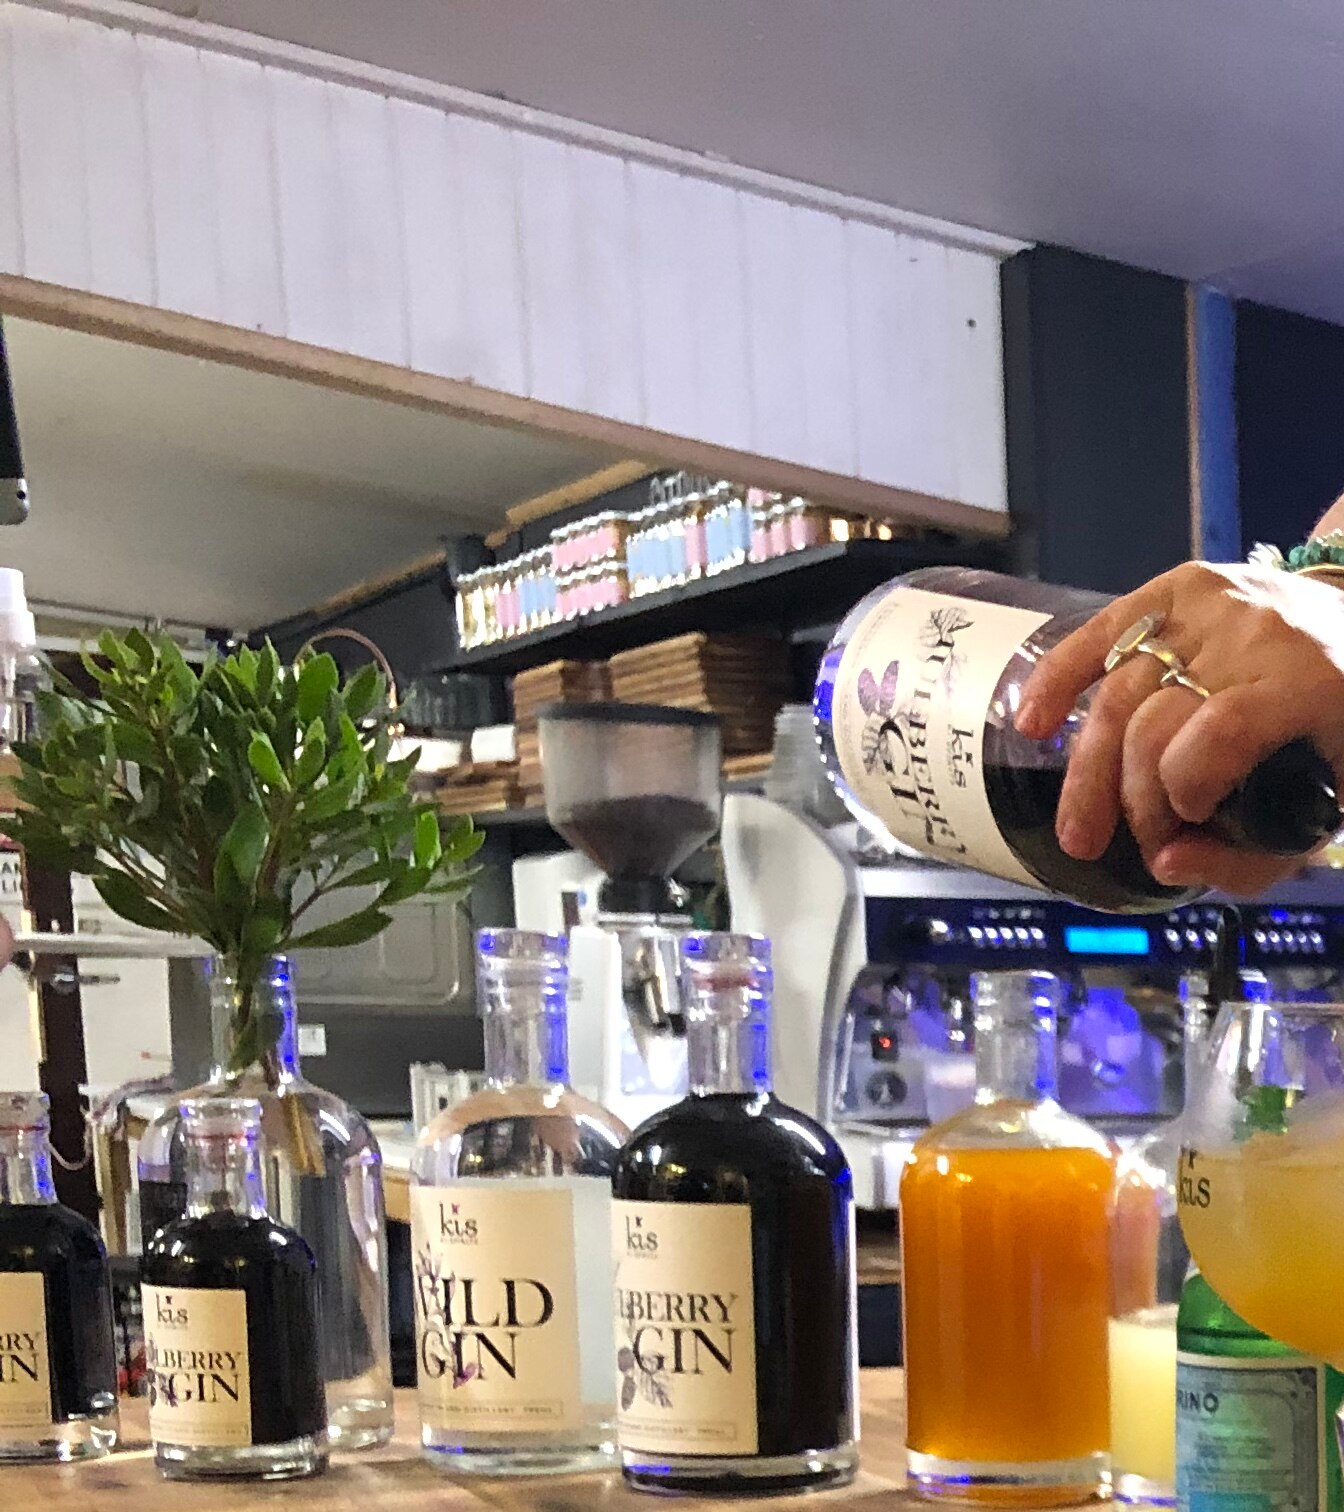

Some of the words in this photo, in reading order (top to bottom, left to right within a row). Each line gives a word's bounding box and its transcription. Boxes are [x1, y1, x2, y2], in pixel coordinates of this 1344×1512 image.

[440, 1203, 478, 1238] kis
[626, 1215, 659, 1251] kis
[156, 1292, 189, 1324] kis
[421, 1329, 519, 1380] GIN
[633, 1326, 737, 1375] GIN
[168, 1372, 240, 1403] GIN
